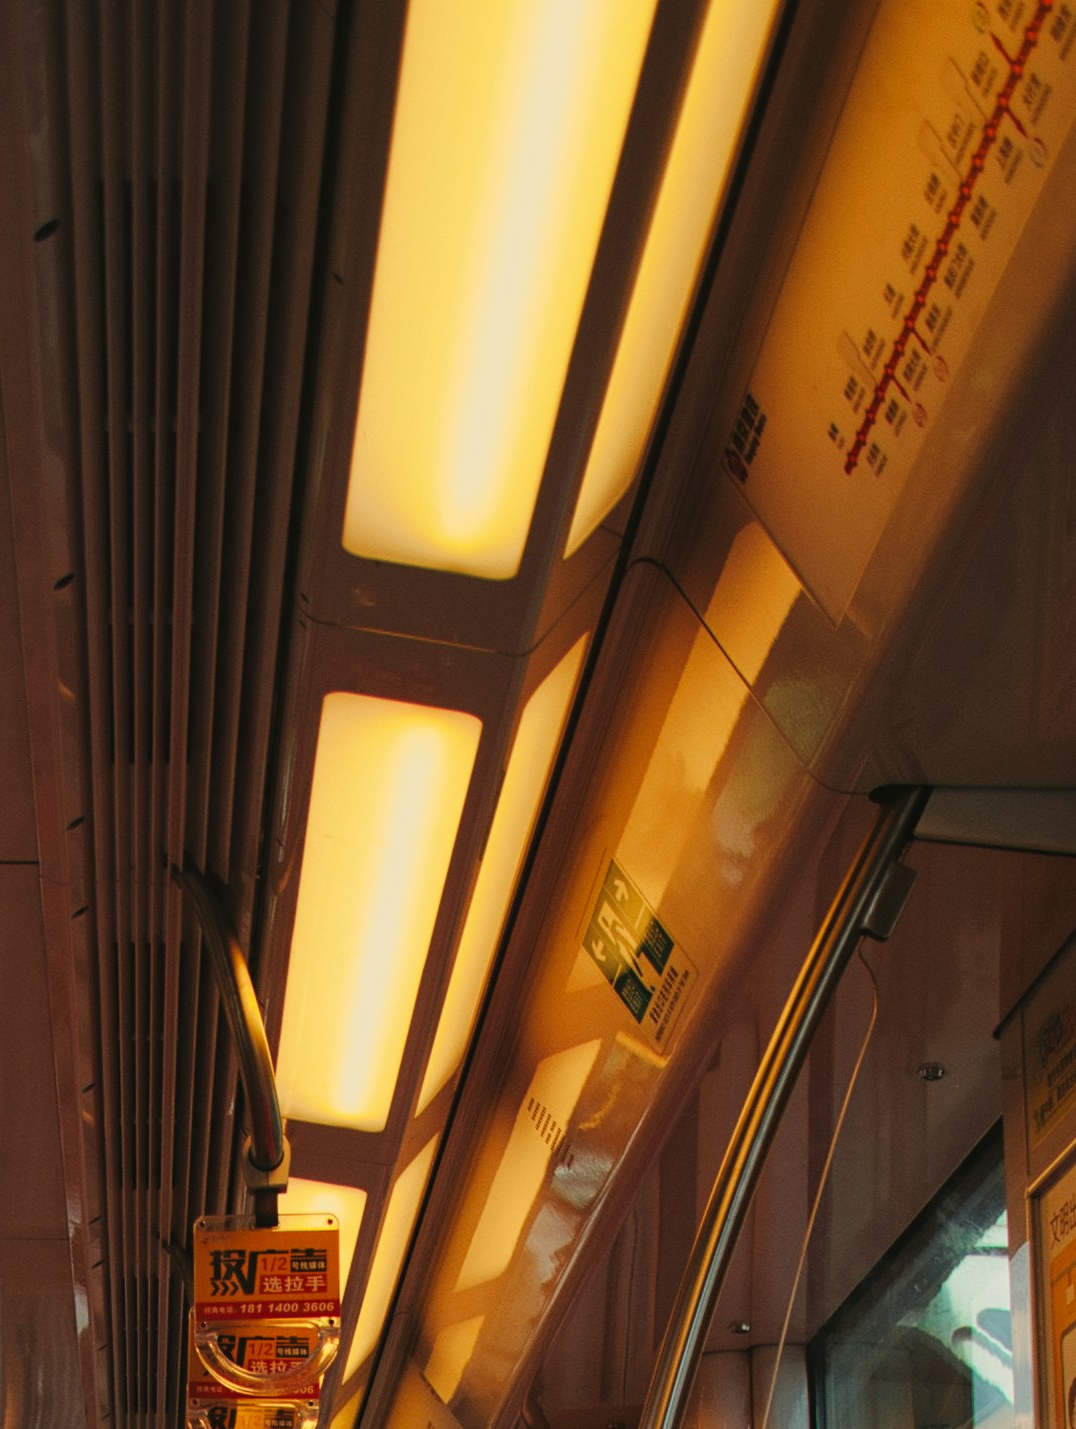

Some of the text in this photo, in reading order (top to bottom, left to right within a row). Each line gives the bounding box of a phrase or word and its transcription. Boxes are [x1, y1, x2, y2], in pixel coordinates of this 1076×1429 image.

[263, 1275, 324, 1293] 选拉手
[240, 1304, 262, 1313] 181
[268, 1303, 299, 1312] 1400
[303, 1302, 334, 1312] 3606
